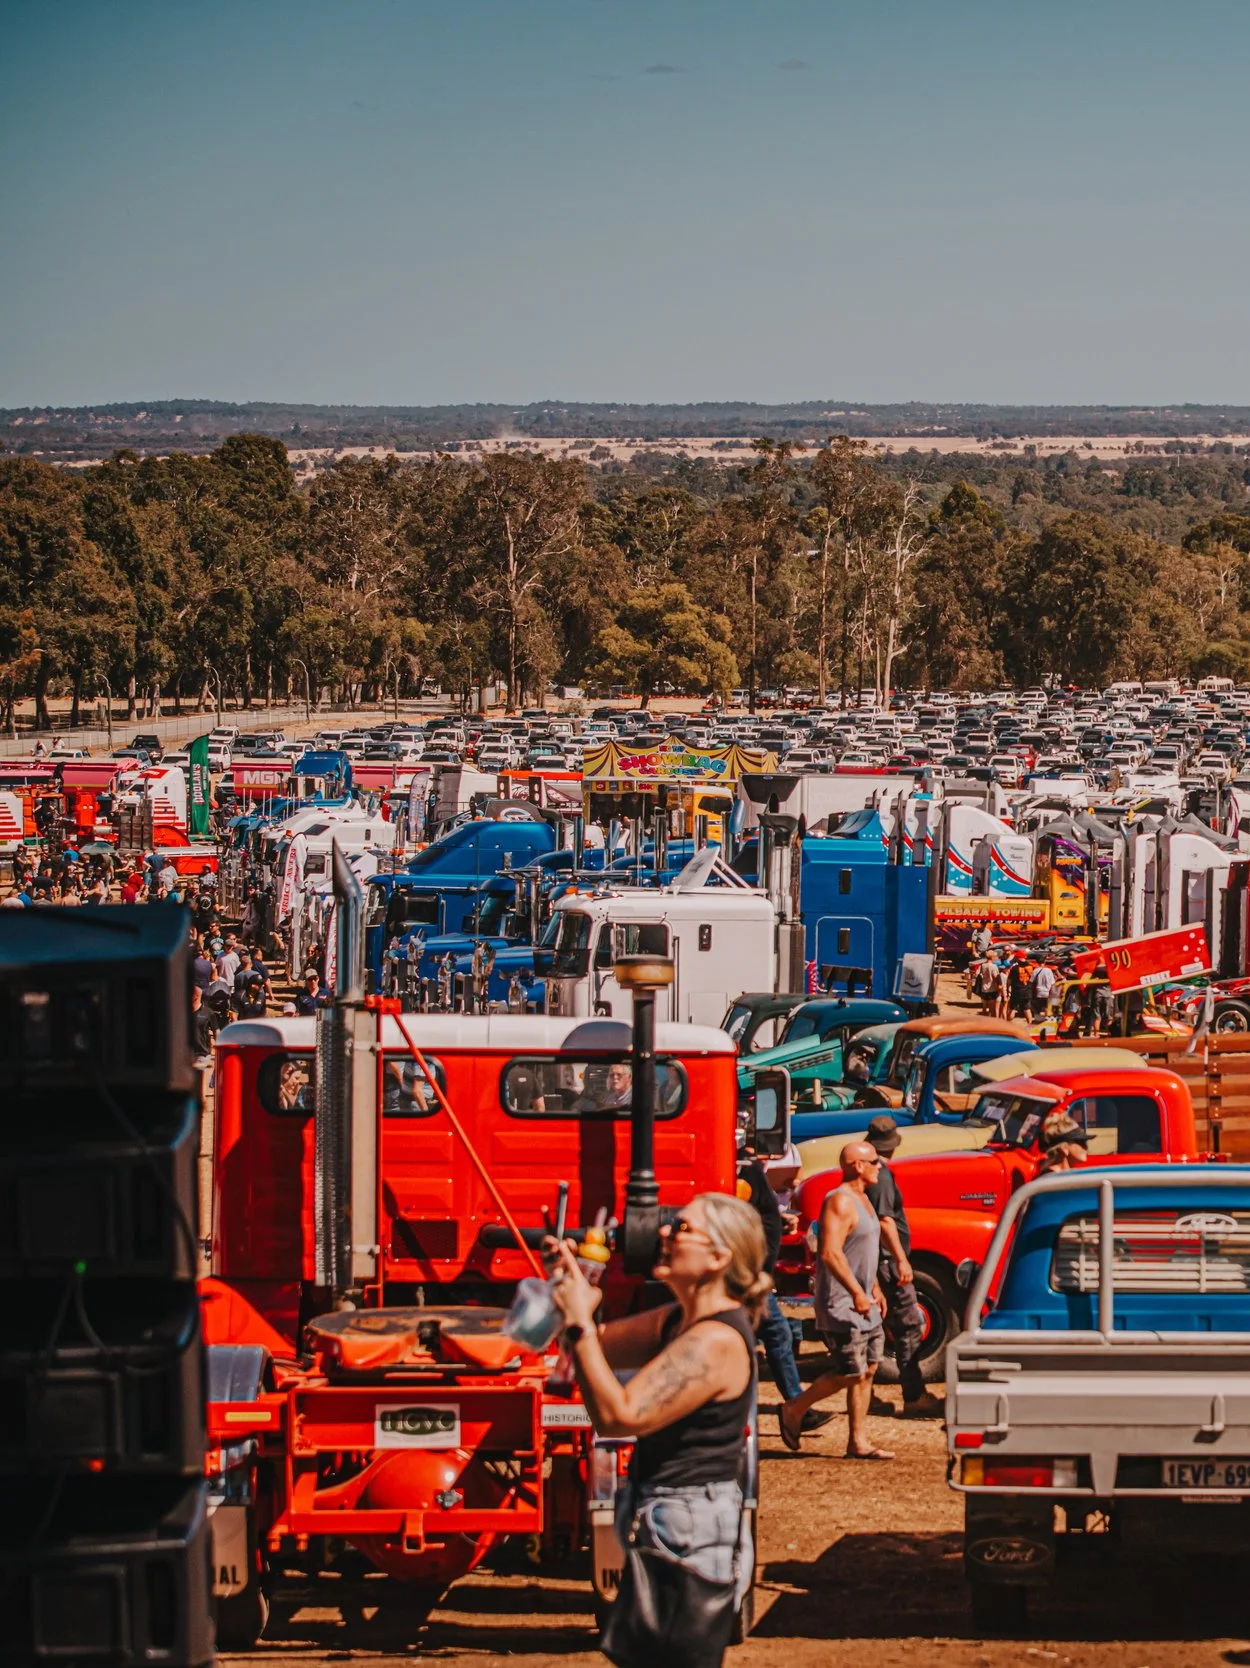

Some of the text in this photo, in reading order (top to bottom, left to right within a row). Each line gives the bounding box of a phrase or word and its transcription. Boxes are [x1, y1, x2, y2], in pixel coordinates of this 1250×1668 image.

[617, 752, 727, 774] SHOWBAG
[936, 907, 1041, 917] PILBARA TOWING
[1110, 949, 1131, 971] 90
